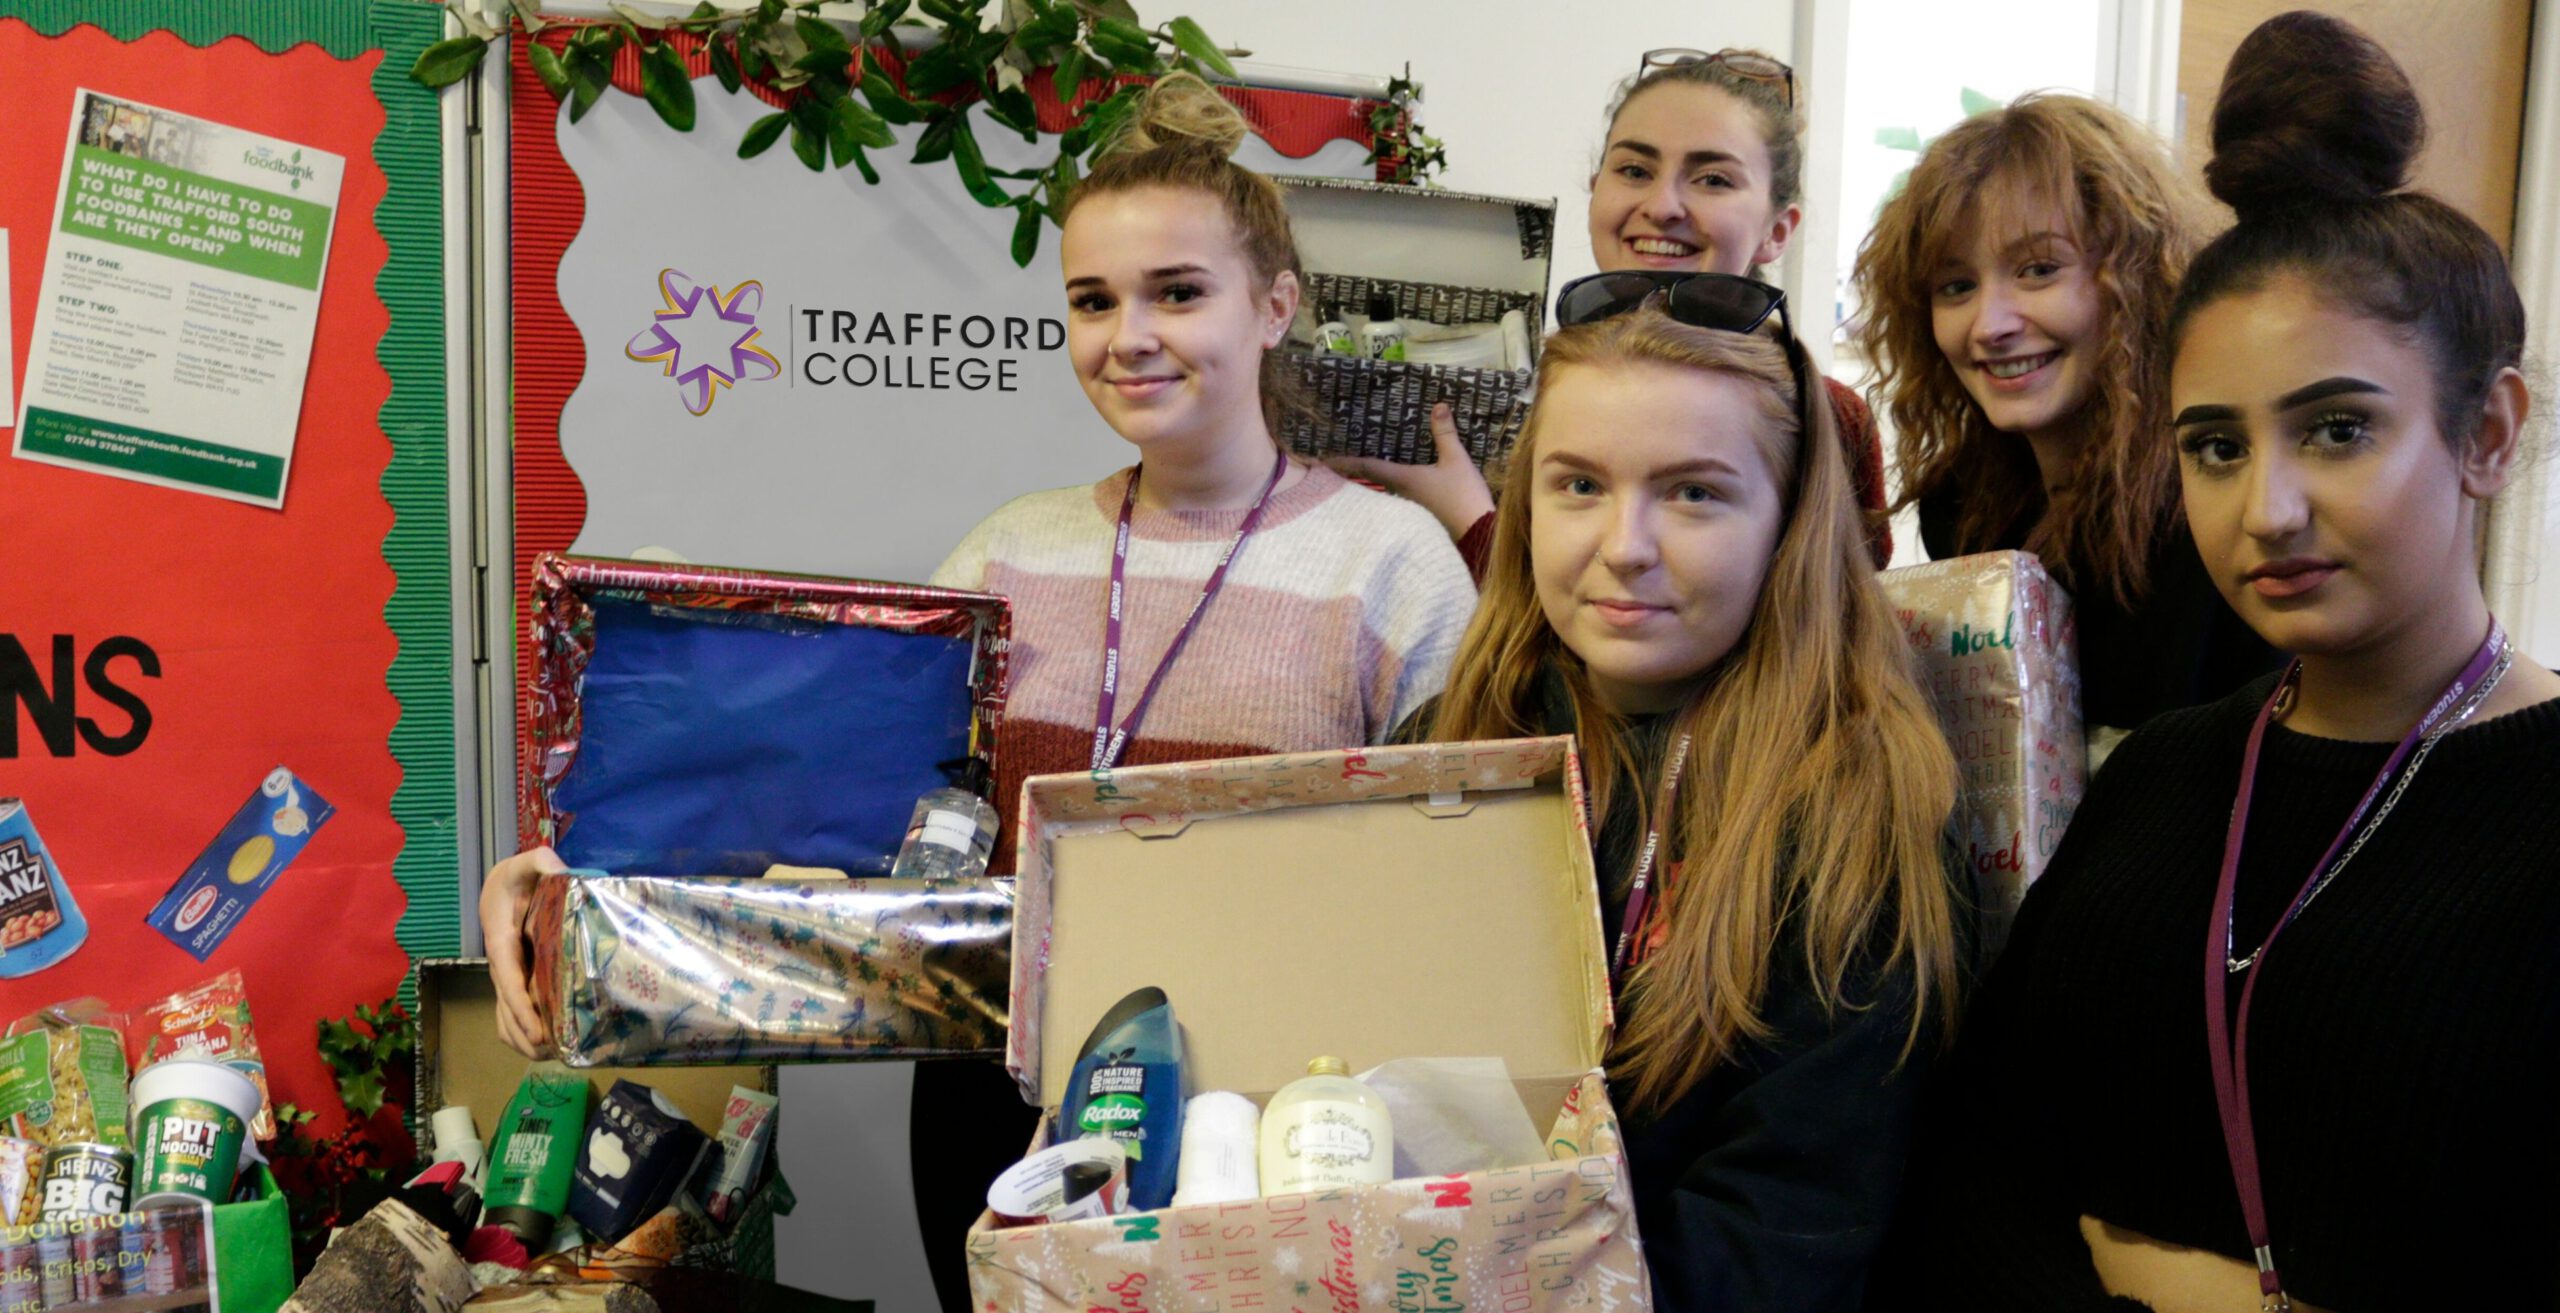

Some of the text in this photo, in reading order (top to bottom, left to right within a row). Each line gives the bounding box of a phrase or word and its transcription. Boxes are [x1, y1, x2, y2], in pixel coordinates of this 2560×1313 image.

[244, 150, 314, 181] foodbank
[79, 175, 304, 242] TO USE TRAFFORD SOUTH
[81, 158, 293, 222] WHAT DO I HAVE TO DO
[72, 210, 226, 257] ARE THEY OPEN?
[76, 193, 184, 230] FOODBANKS
[205, 225, 242, 244] AND
[249, 234, 302, 259] WHEN
[65, 251, 93, 264] STEP
[97, 258, 124, 271] ONE:
[58, 295, 86, 307] STEP
[803, 308, 1066, 351] TRAFFORD
[803, 352, 1018, 392] COLLEGE
[91, 427, 258, 470] www.traffordsouth.foodbank.org.uk
[1116, 521, 1129, 559] STUDENT
[1110, 580, 1122, 622] STUDENT
[1951, 611, 2019, 657] Noel
[1104, 648, 1118, 695] STUDENT
[2418, 681, 2464, 736] STUDENT
[1091, 726, 1108, 768] STUDEN
[1666, 733, 1692, 790] STUDENT
[1633, 830, 1660, 889] STUDENT
[191, 897, 239, 949] SPAGHETTI
[1101, 1085, 1141, 1093] FRAGRANCE
[1102, 1076, 1142, 1086] INSPIRED
[1103, 1067, 1144, 1077] NATURE
[162, 1116, 222, 1148] POT
[516, 1117, 553, 1134] ZINGY
[1083, 1102, 1142, 1124] Radox
[160, 1140, 215, 1161] NOODLE
[507, 1132, 554, 1153] MINTY
[1113, 1130, 1138, 1139] MEN
[59, 1157, 119, 1182] HEINZ
[503, 1148, 549, 1167] FRESH
[42, 1177, 126, 1217] BIG
[44, 1256, 114, 1281] Crisps,
[118, 1249, 153, 1269] Dry
